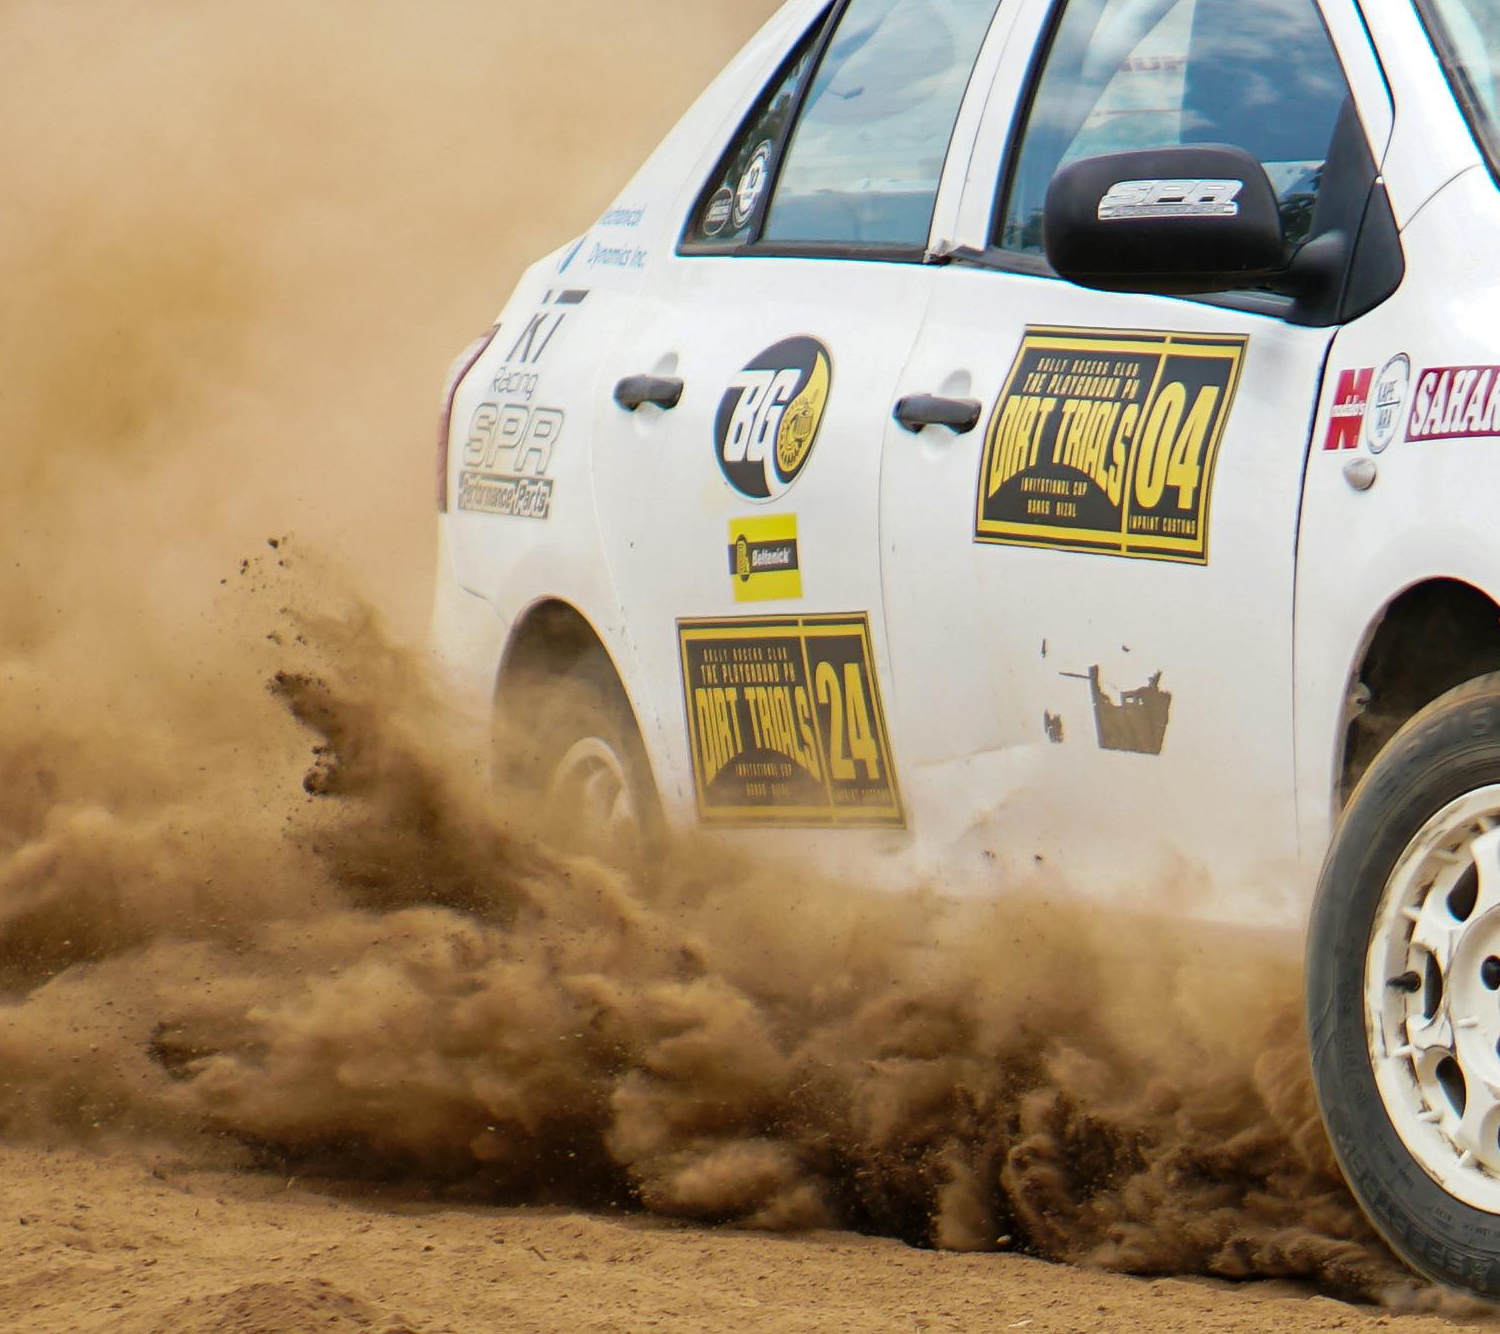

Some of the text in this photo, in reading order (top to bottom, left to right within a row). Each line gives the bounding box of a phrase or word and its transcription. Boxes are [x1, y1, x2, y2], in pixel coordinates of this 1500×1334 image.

[1022, 371, 1141, 400] THE PLAYGROUND PH
[1036, 357, 1068, 372] RALLY
[1113, 361, 1141, 377] CLUB
[462, 402, 565, 476] SPR
[988, 394, 1141, 508] DIRT TRIALS
[1134, 380, 1220, 510] 04
[694, 686, 822, 786] DIRT TRIALS
[815, 661, 880, 780] 24
